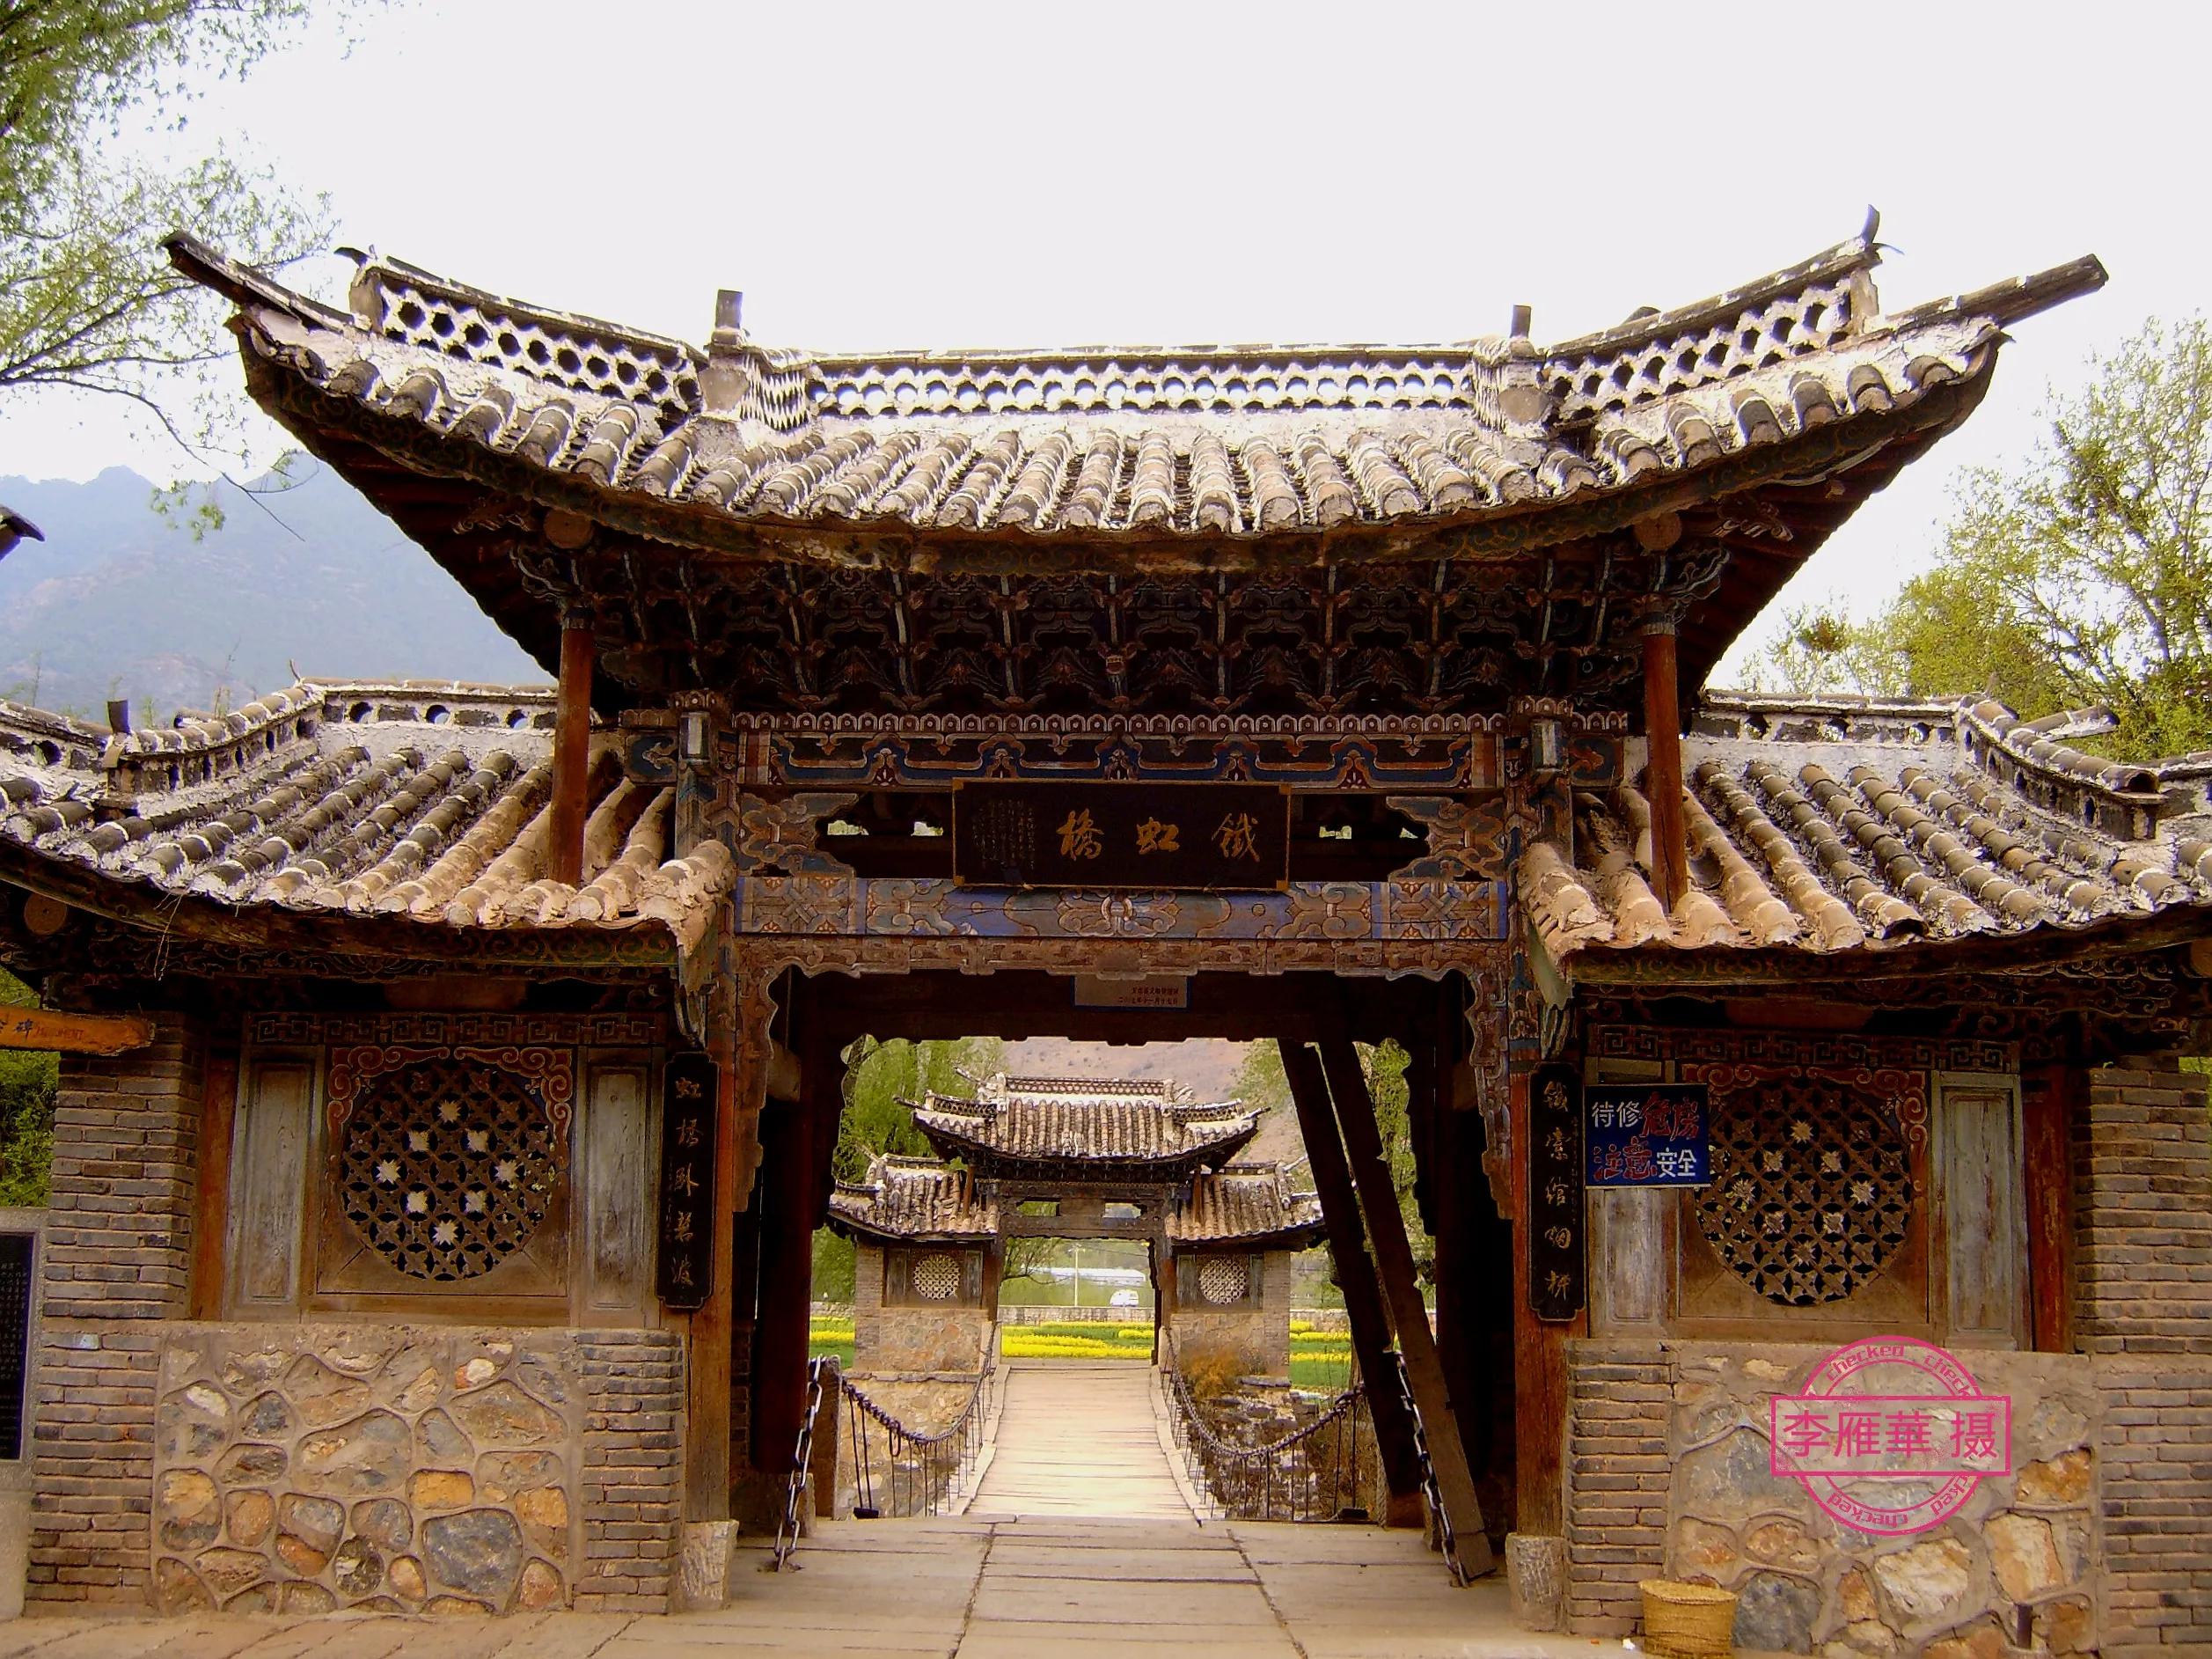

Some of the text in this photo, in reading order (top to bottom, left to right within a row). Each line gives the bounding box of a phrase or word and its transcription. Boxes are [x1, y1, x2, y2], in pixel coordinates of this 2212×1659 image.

[1591, 1091, 1700, 1141] 待修危房
[1593, 1135, 1697, 1181] 注意安全
